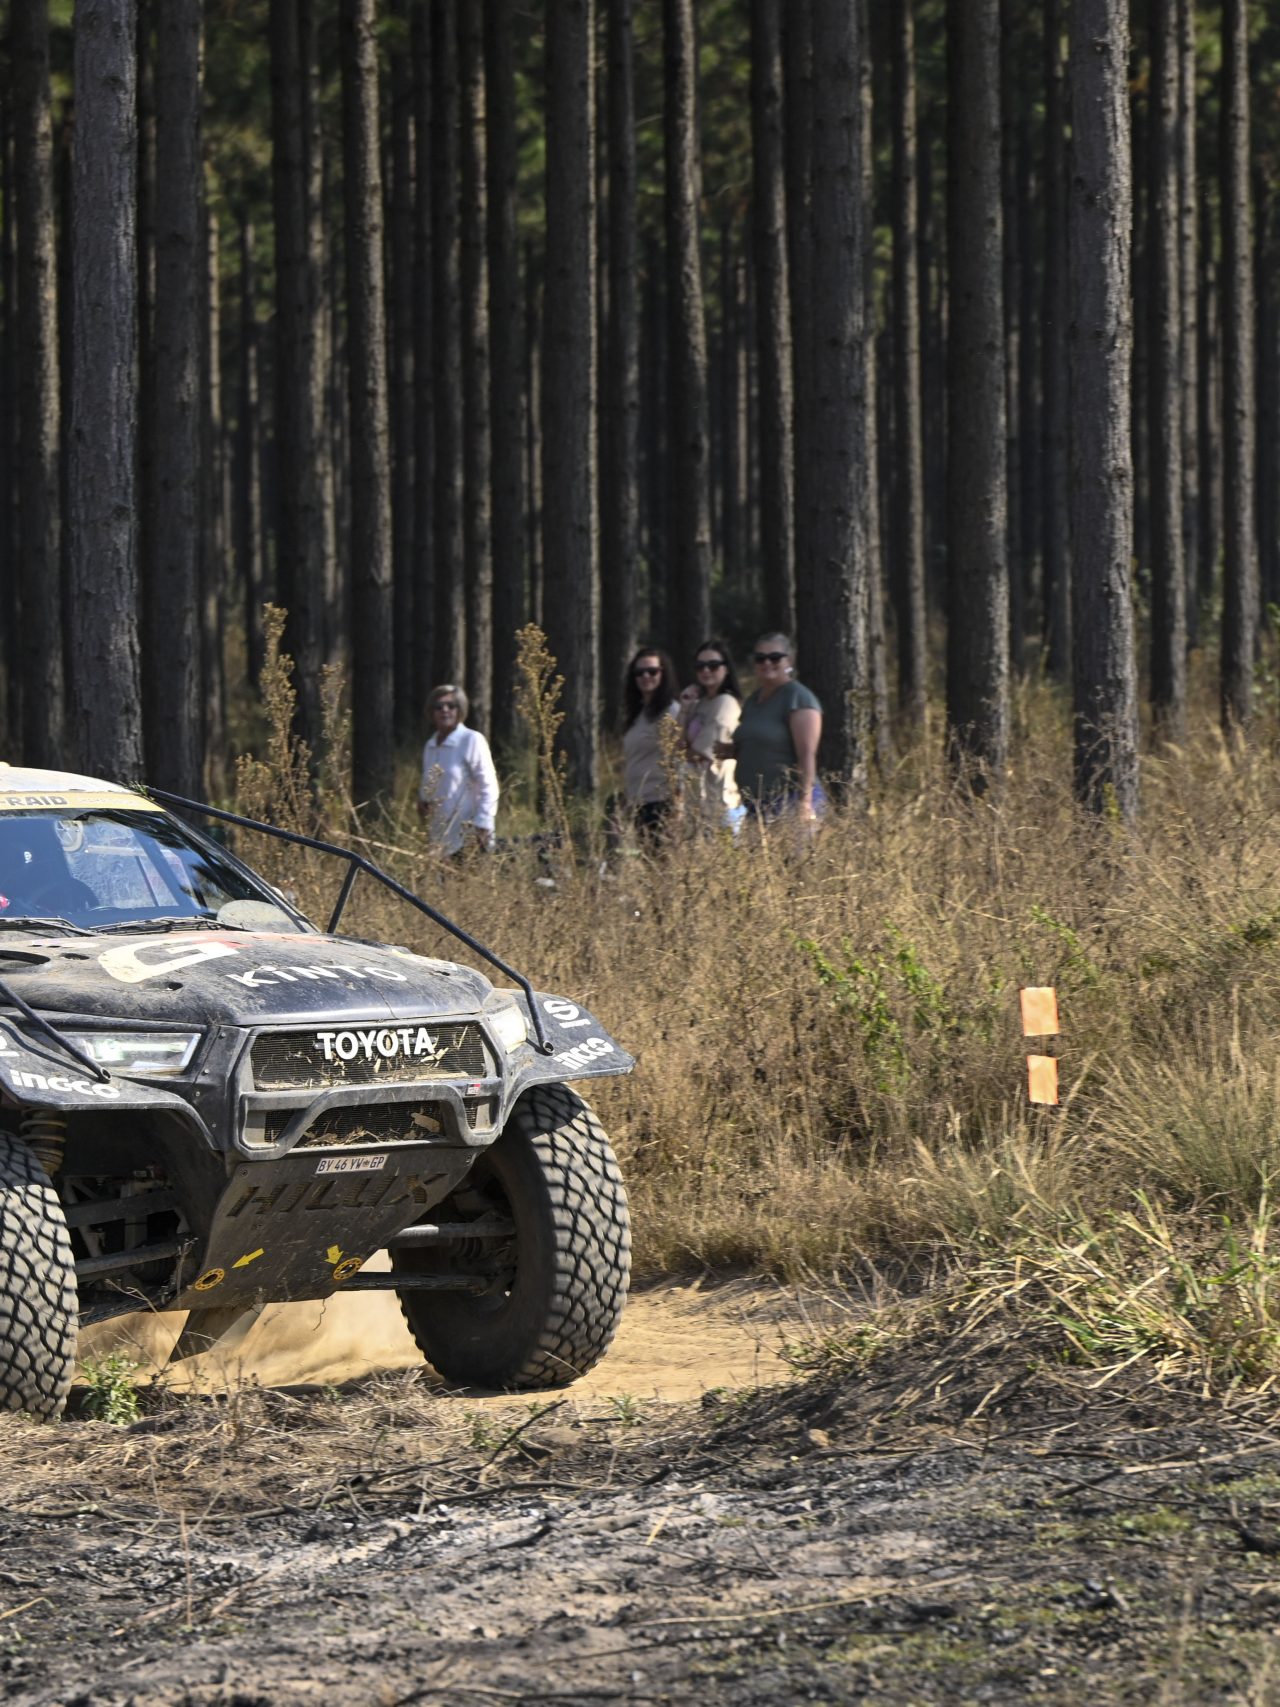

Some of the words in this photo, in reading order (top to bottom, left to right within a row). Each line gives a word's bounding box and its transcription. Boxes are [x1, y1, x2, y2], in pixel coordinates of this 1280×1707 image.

[317, 1028, 435, 1061] TOYOTA
[318, 1160, 331, 1172] BY
[334, 1159, 347, 1171] 46
[349, 1157, 363, 1170] YW
[370, 1156, 384, 1168] GP
[227, 1173, 448, 1217] HILUX
